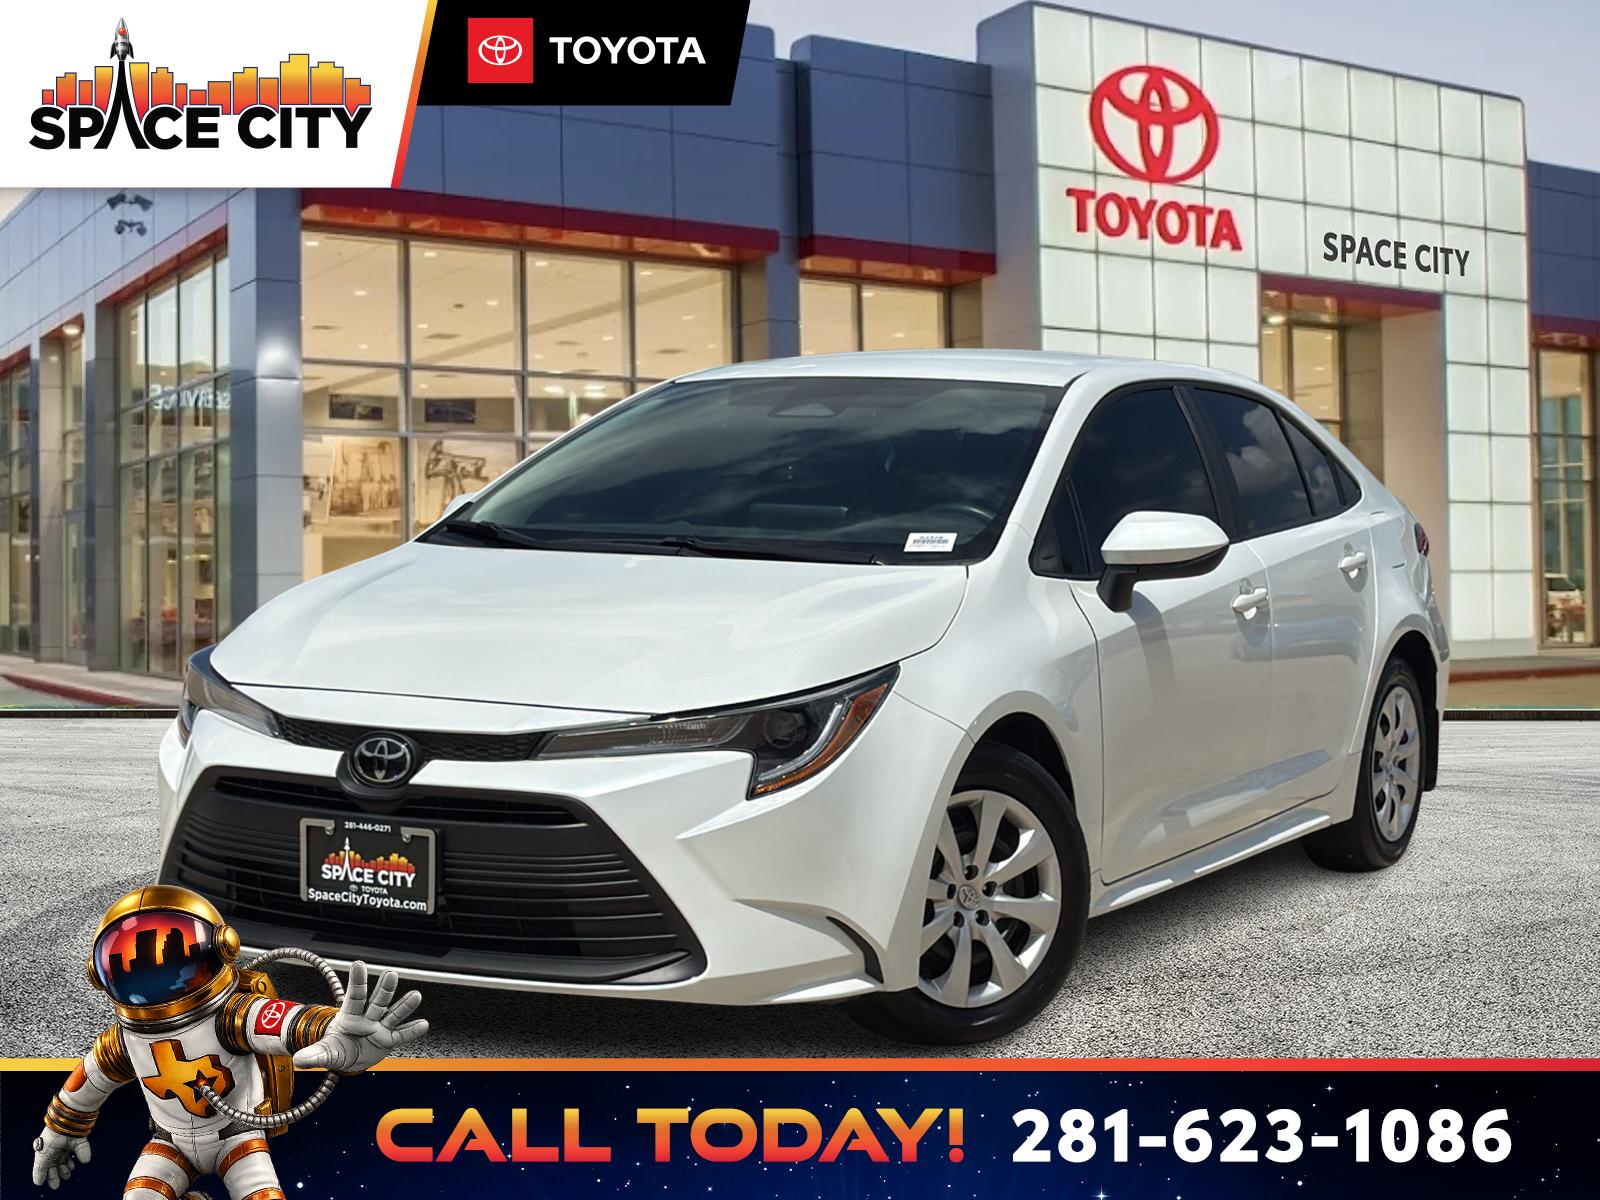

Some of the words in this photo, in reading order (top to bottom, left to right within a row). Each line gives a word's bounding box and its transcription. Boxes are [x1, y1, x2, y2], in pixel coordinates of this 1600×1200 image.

[1066, 187, 1242, 251] TOYOTA
[1323, 232, 1406, 269] SPACE
[1414, 244, 1470, 277] CITY
[321, 863, 374, 884] SPACE
[377, 870, 416, 888] CITY
[308, 889, 427, 911] SpaceCityToyota.com
[362, 886, 388, 895] TOYOTA
